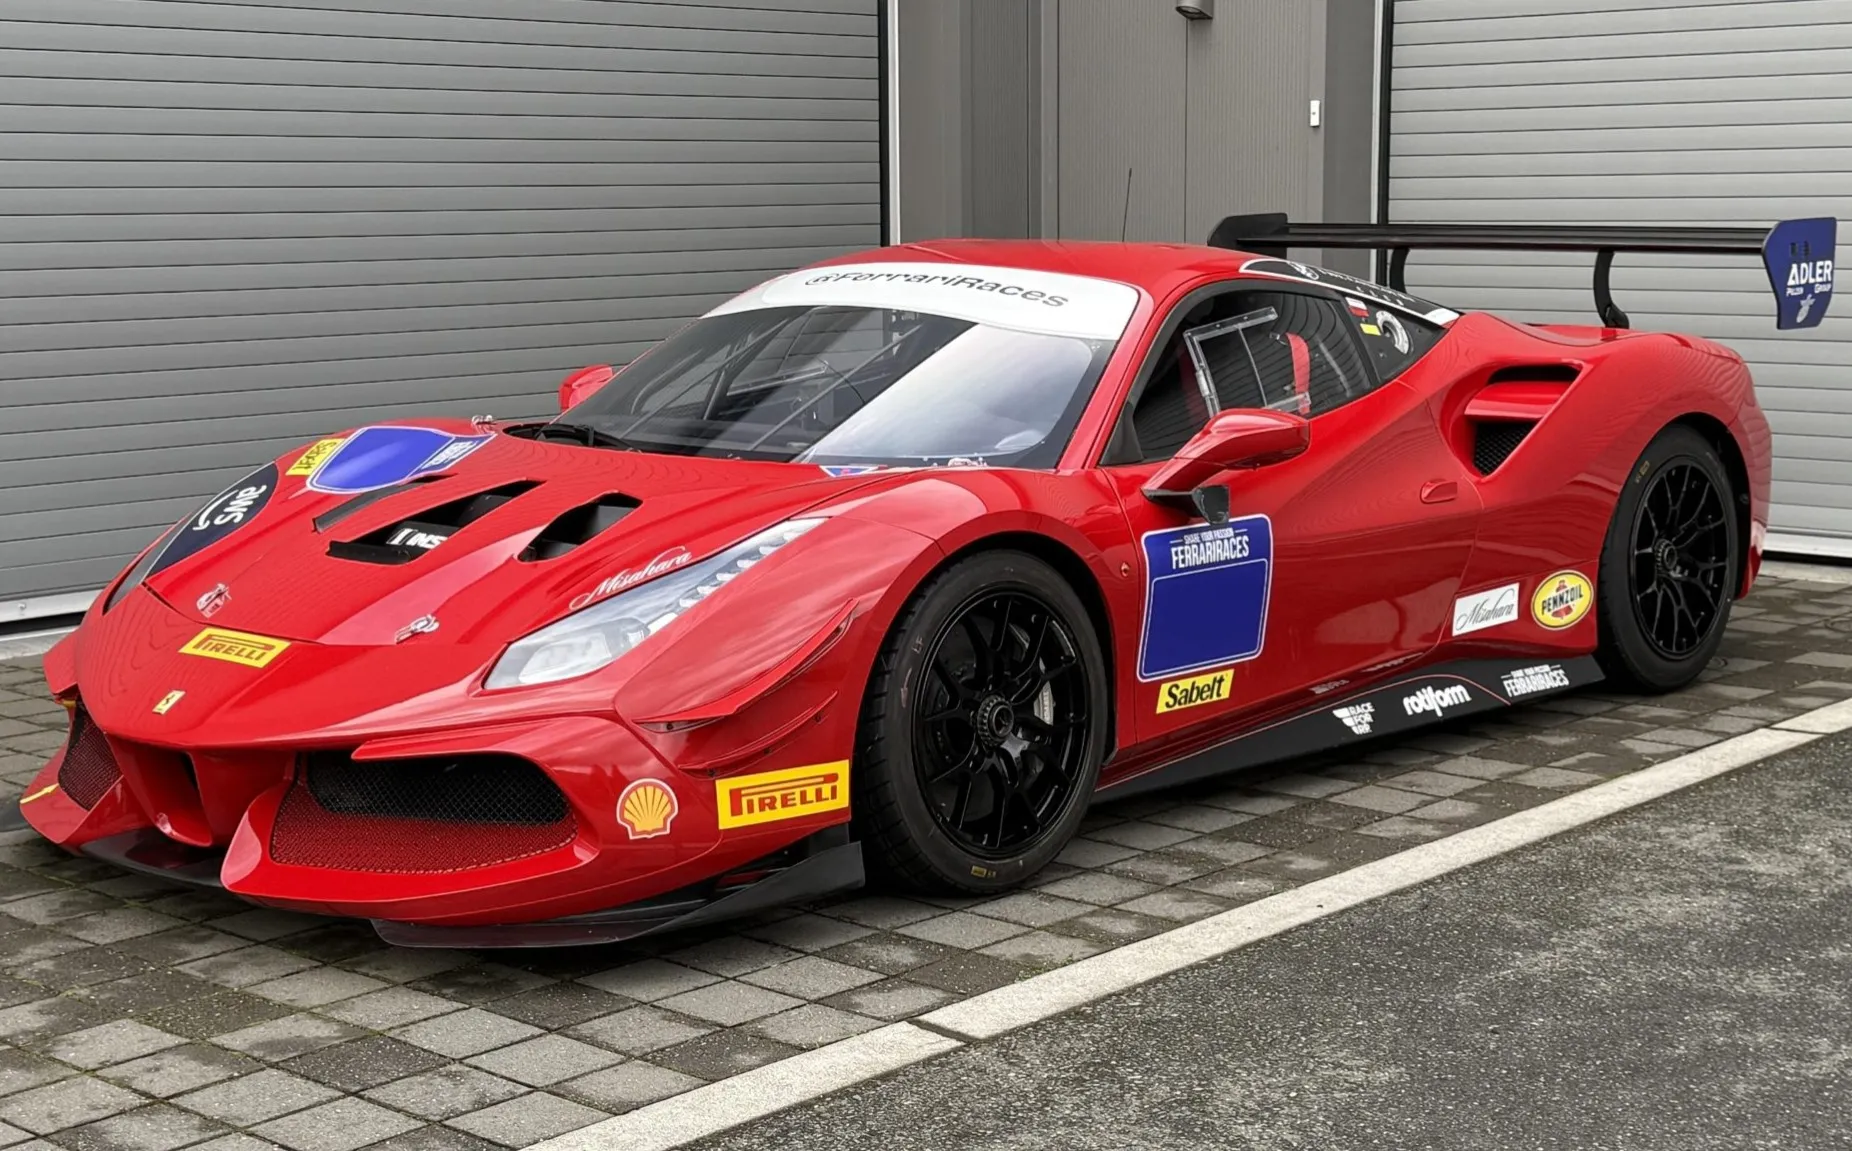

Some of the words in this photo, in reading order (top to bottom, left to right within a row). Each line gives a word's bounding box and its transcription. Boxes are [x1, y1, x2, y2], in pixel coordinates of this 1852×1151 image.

[805, 272, 1069, 308] @FerrariRaces
[1786, 260, 1833, 287] ADLER
[1170, 535, 1250, 570] FERRARIRACES
[568, 545, 692, 611] Misahara
[1455, 588, 1516, 631] Misahara
[1541, 584, 1584, 616] PENNZOIL
[192, 633, 277, 661] PIRELLI
[1165, 674, 1225, 709] Sabelt
[1348, 701, 1376, 716] RACE
[1402, 684, 1473, 717] rotiform
[1352, 712, 1375, 726] FOR
[729, 772, 840, 818] PIRELLI
